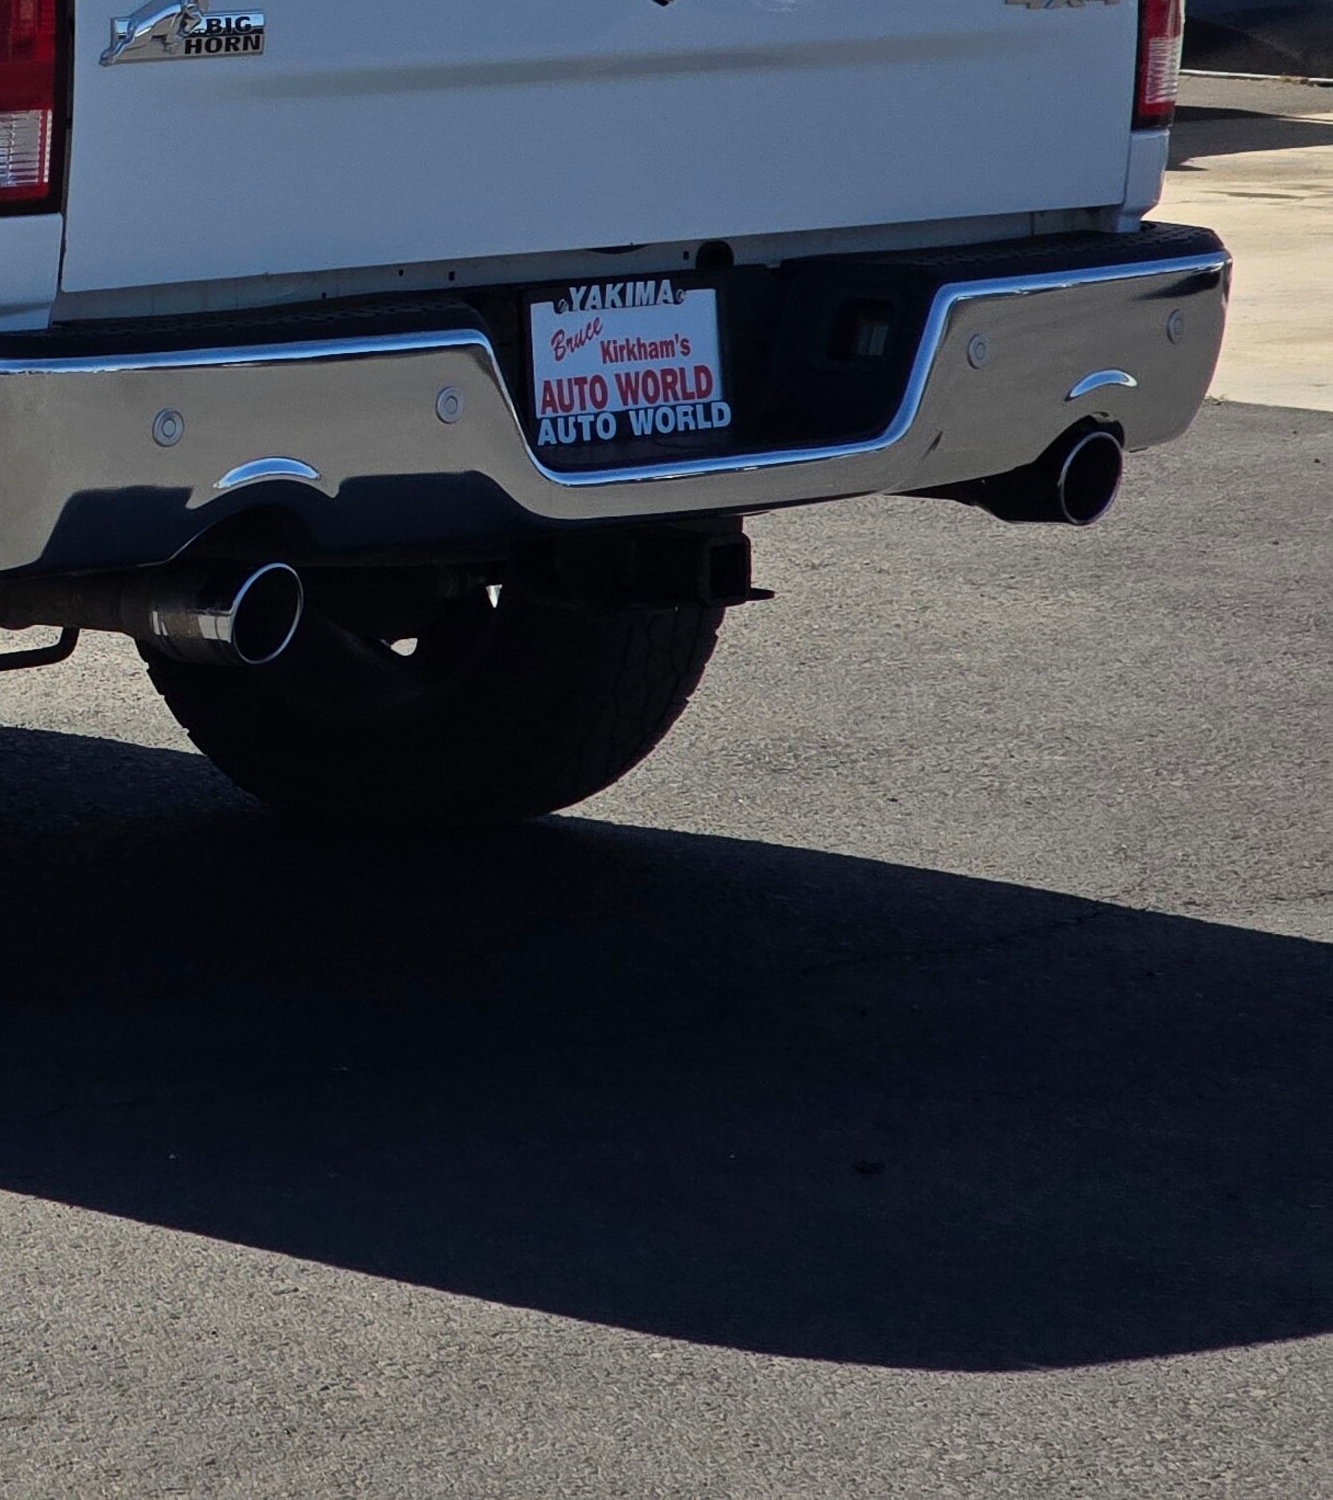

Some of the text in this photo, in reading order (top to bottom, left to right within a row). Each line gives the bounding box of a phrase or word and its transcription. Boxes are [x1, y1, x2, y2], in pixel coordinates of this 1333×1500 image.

[206, 16, 252, 33] BIG
[184, 35, 261, 54] HORN
[569, 279, 674, 312] YAKIMA
[551, 316, 691, 364] Bruce Kirkham's
[540, 364, 714, 415] AUTO WORLD
[538, 401, 732, 446] AUTO WORLD
